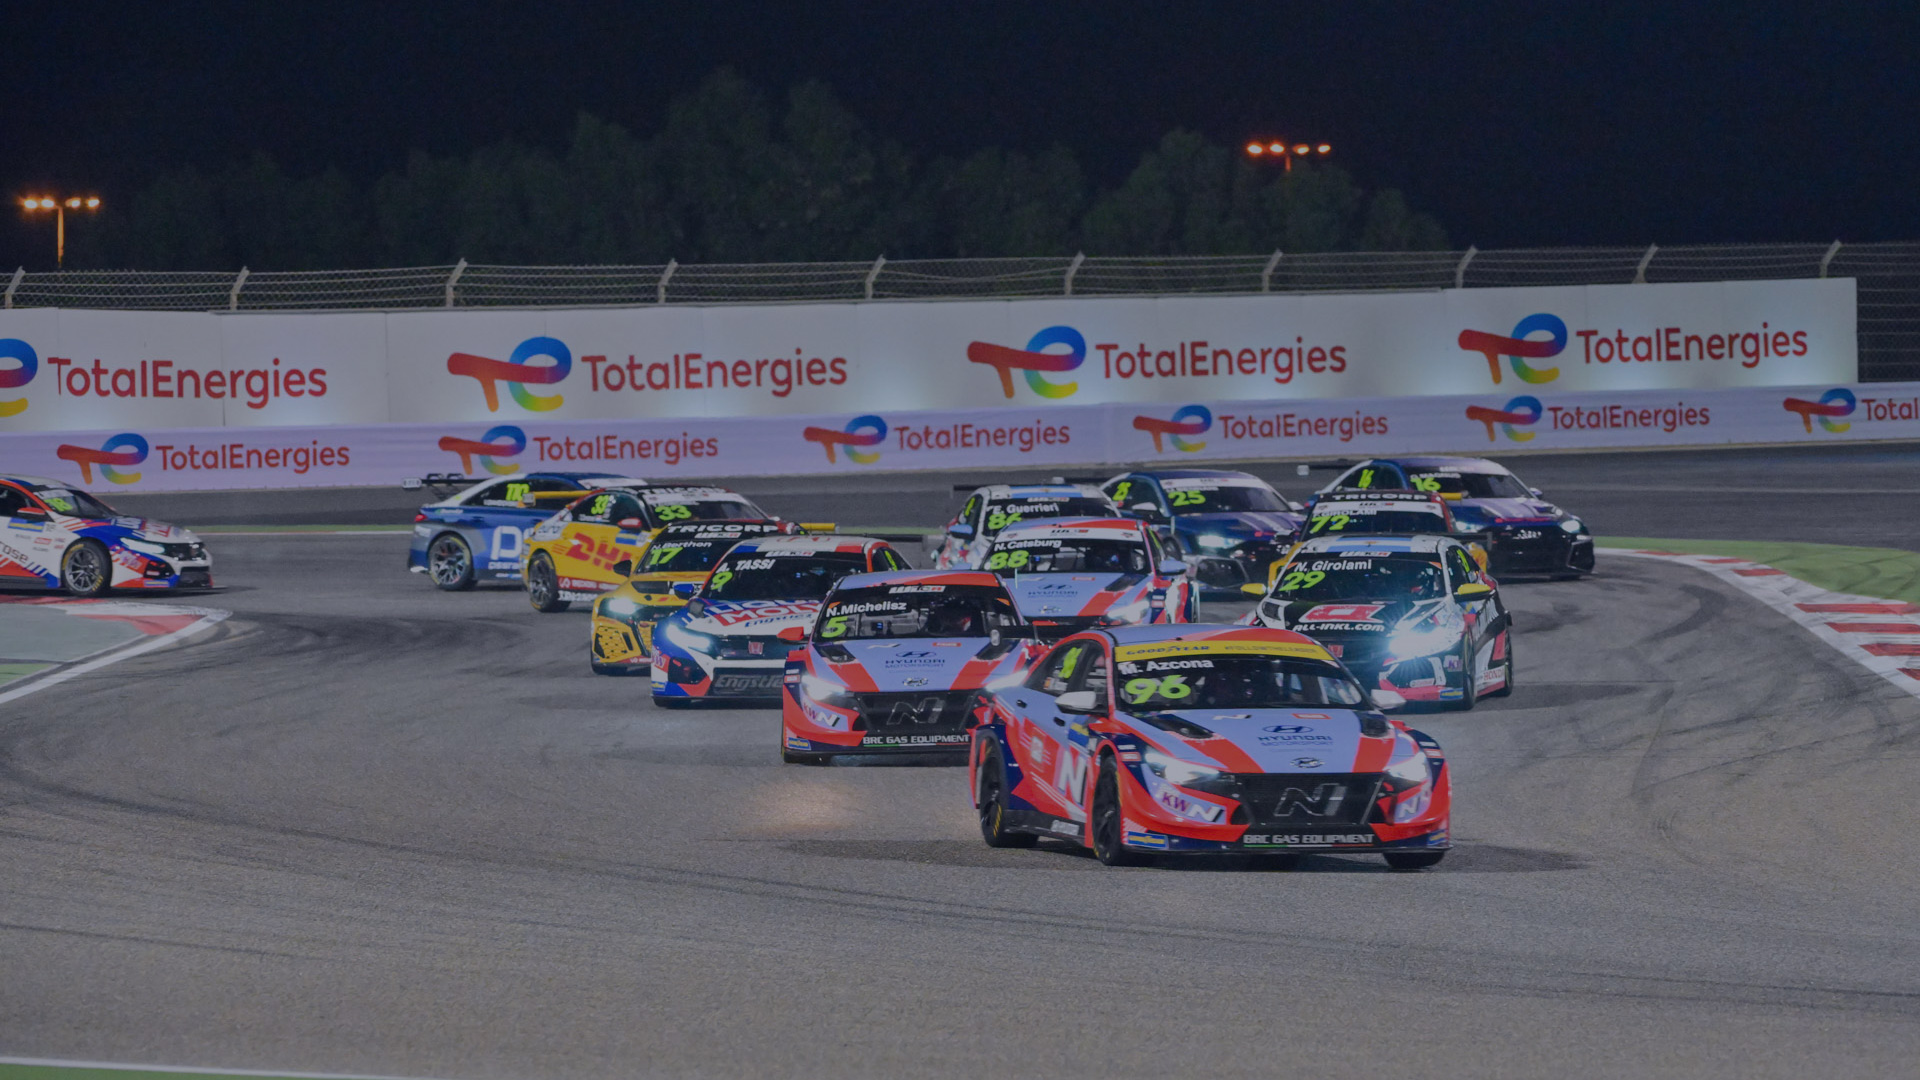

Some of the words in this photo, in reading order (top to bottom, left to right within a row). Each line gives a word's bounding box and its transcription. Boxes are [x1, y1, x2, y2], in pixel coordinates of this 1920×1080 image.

[1576, 322, 1808, 369] TotalEnergies
[1096, 336, 1347, 385] TotalEnergies
[48, 358, 328, 410] TotalEnergies
[582, 352, 847, 398] TotalEnergies
[1862, 398, 1920, 420] Total
[1220, 415, 1388, 441] TotalEnergies
[1550, 407, 1709, 433] TotalEnergies
[895, 419, 1070, 452] TotalEnergies
[156, 441, 350, 475] TotalEnergies
[533, 434, 718, 466] TotalEnergies
[1168, 490, 1206, 507] 25
[1332, 493, 1428, 501] TRICORP
[655, 505, 692, 521] 33
[1006, 502, 1060, 514] Guerrieri
[667, 524, 779, 533] TRICORP
[1309, 514, 1350, 534] 72
[650, 546, 684, 565] 17
[735, 559, 776, 571] TASSI
[989, 550, 1030, 570] 88
[1311, 559, 1372, 572] Girolami
[711, 571, 734, 590] 9
[1279, 570, 1326, 592] 29
[821, 616, 848, 639] 5
[1146, 659, 1215, 672] Azcona
[714, 674, 783, 692] Engstle
[1124, 674, 1192, 704] 96
[863, 736, 883, 744] BRC
[886, 736, 908, 744] GAS
[910, 734, 970, 744] EQUIPMENT
[1243, 834, 1271, 844] BRC
[1274, 834, 1300, 844] GAS
[1302, 833, 1374, 844] EQUIPMENT
